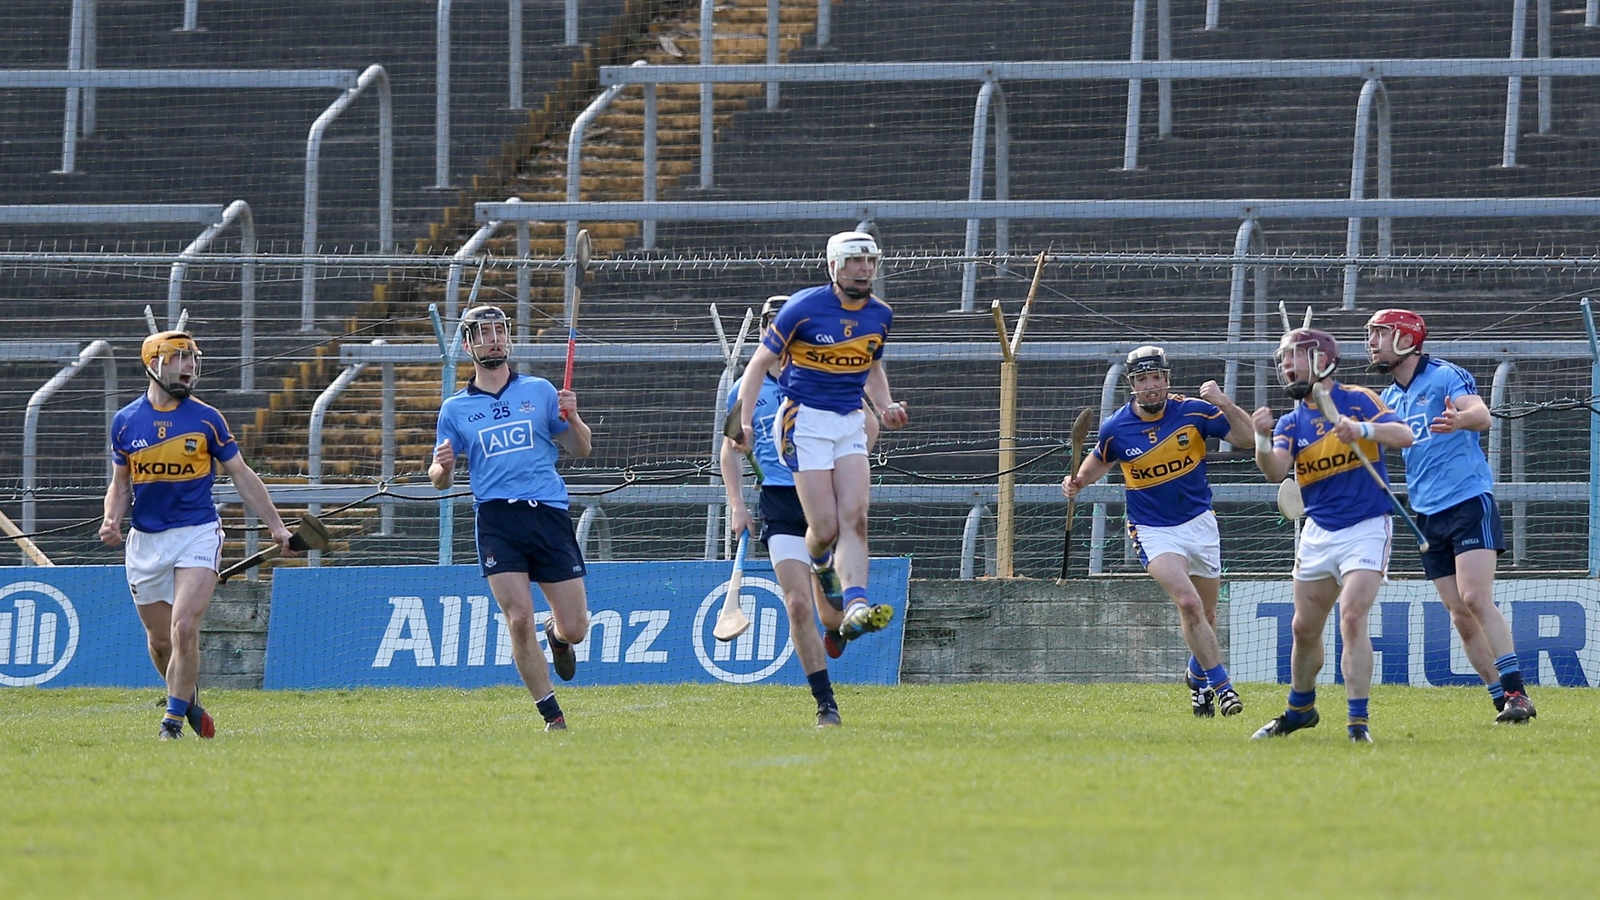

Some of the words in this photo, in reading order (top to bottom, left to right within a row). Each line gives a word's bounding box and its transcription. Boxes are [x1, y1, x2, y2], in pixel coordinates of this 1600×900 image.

[843, 325, 852, 338] 6
[492, 406, 511, 420] 25
[157, 426, 167, 439] 8
[1315, 422, 1325, 436] 2
[488, 427, 526, 451] AIG
[1148, 431, 1158, 444] 5
[1256, 601, 1600, 687] THUR
